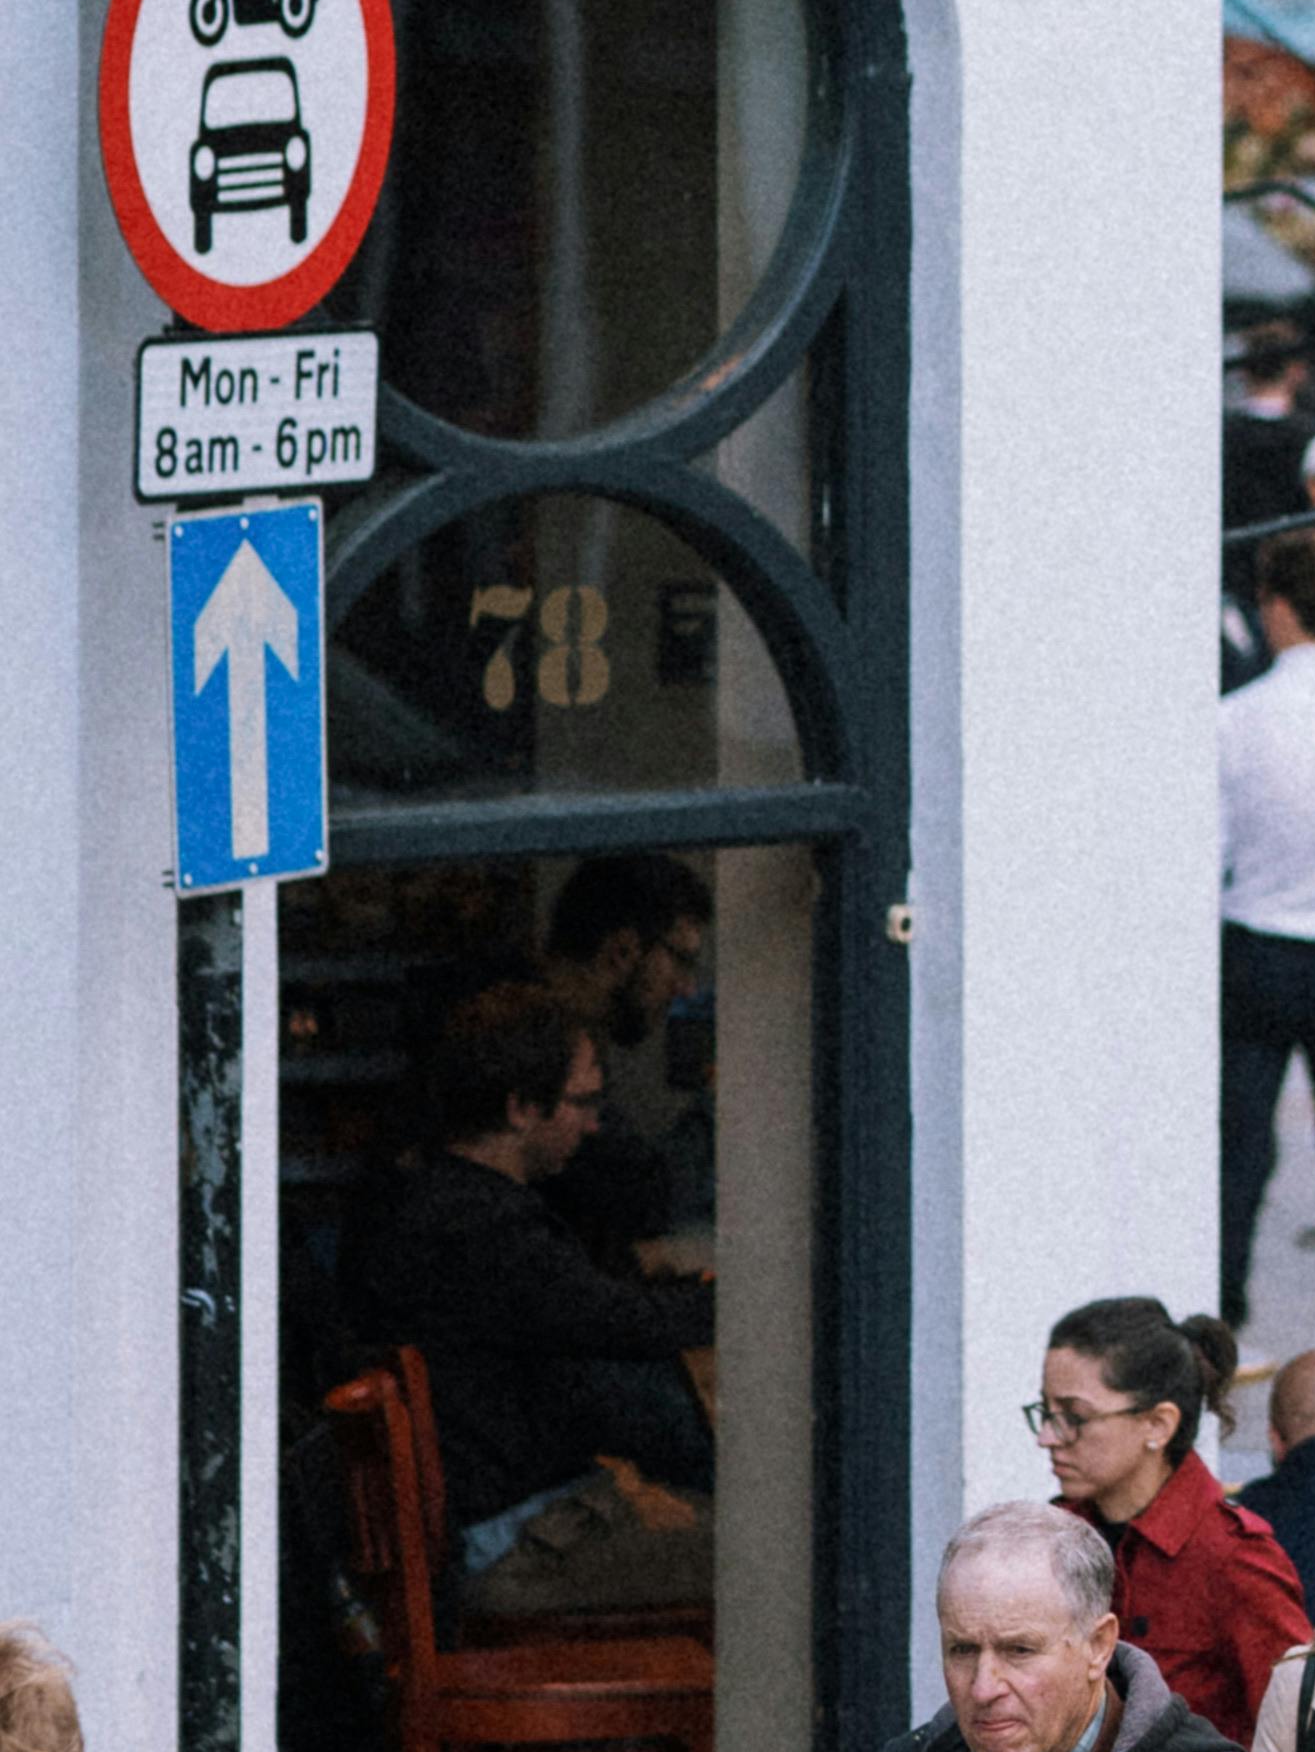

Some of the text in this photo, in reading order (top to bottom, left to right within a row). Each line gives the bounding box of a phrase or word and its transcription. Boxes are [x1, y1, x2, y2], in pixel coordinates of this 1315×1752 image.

[180, 356, 258, 407] Mon
[295, 348, 340, 400] Fri
[469, 584, 611, 712] 78
